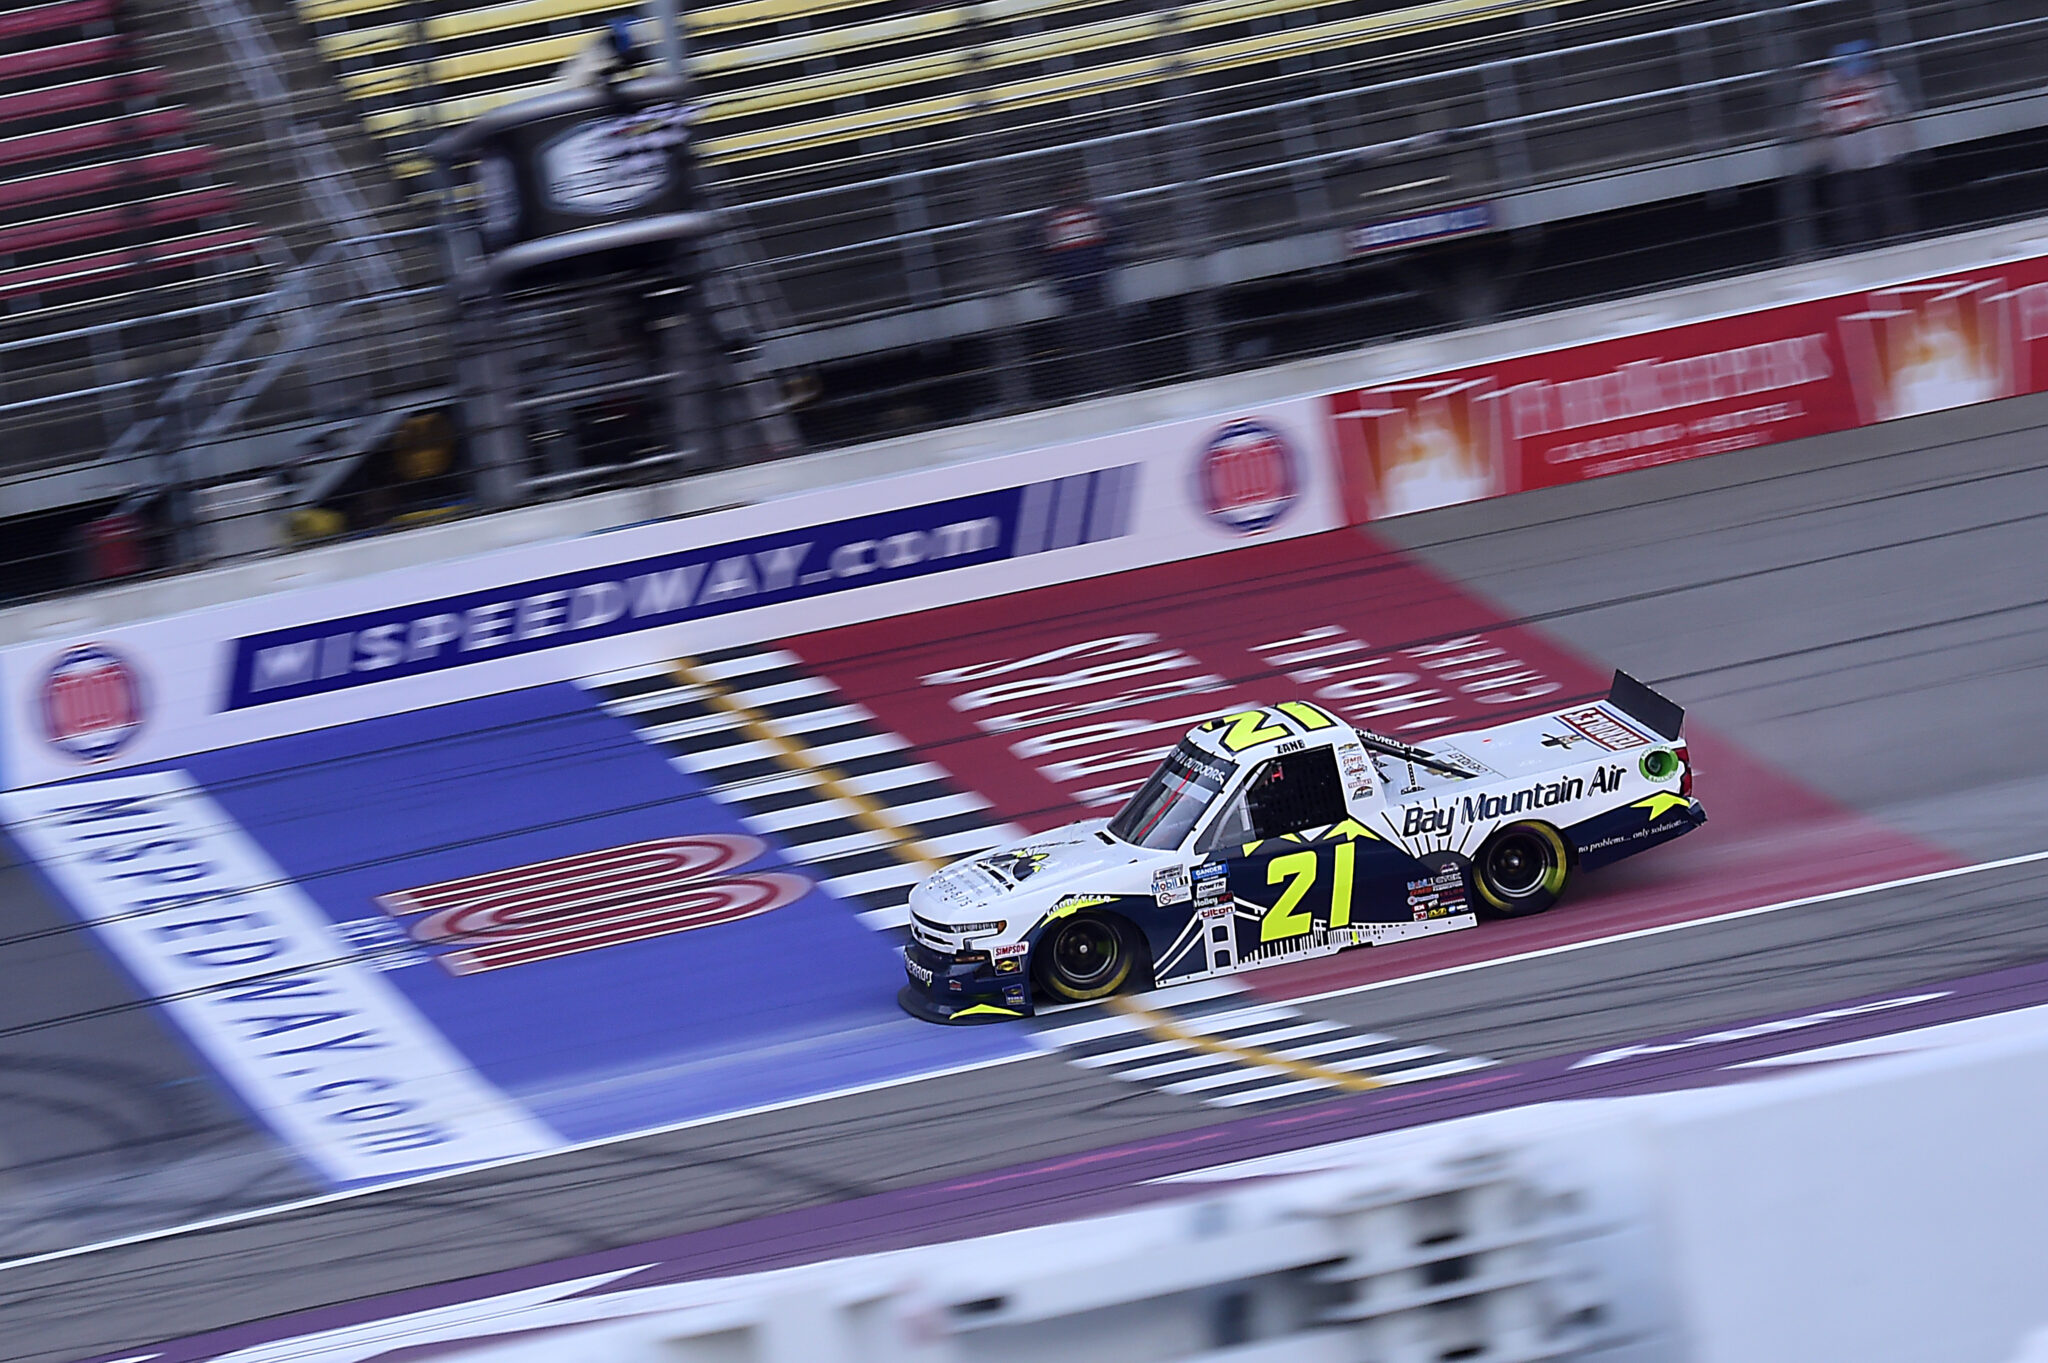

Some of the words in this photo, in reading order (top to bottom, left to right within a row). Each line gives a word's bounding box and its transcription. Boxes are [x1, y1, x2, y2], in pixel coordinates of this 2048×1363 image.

[249, 516, 1000, 693] MISPEEDWAY.com
[1198, 701, 1338, 757] 21
[1403, 806, 1455, 838] Bay
[1460, 775, 1584, 825] Mountain
[1587, 764, 1628, 797] Air
[1578, 845, 1588, 853] no
[1633, 829, 1650, 840] only
[1151, 878, 1178, 894] Mobil
[1260, 842, 1355, 942] 21
[1047, 893, 1111, 917] GOODYEAR
[1194, 897, 1218, 908] Holley
[1201, 906, 1234, 918] tilton
[995, 944, 1026, 956] SIMPSON
